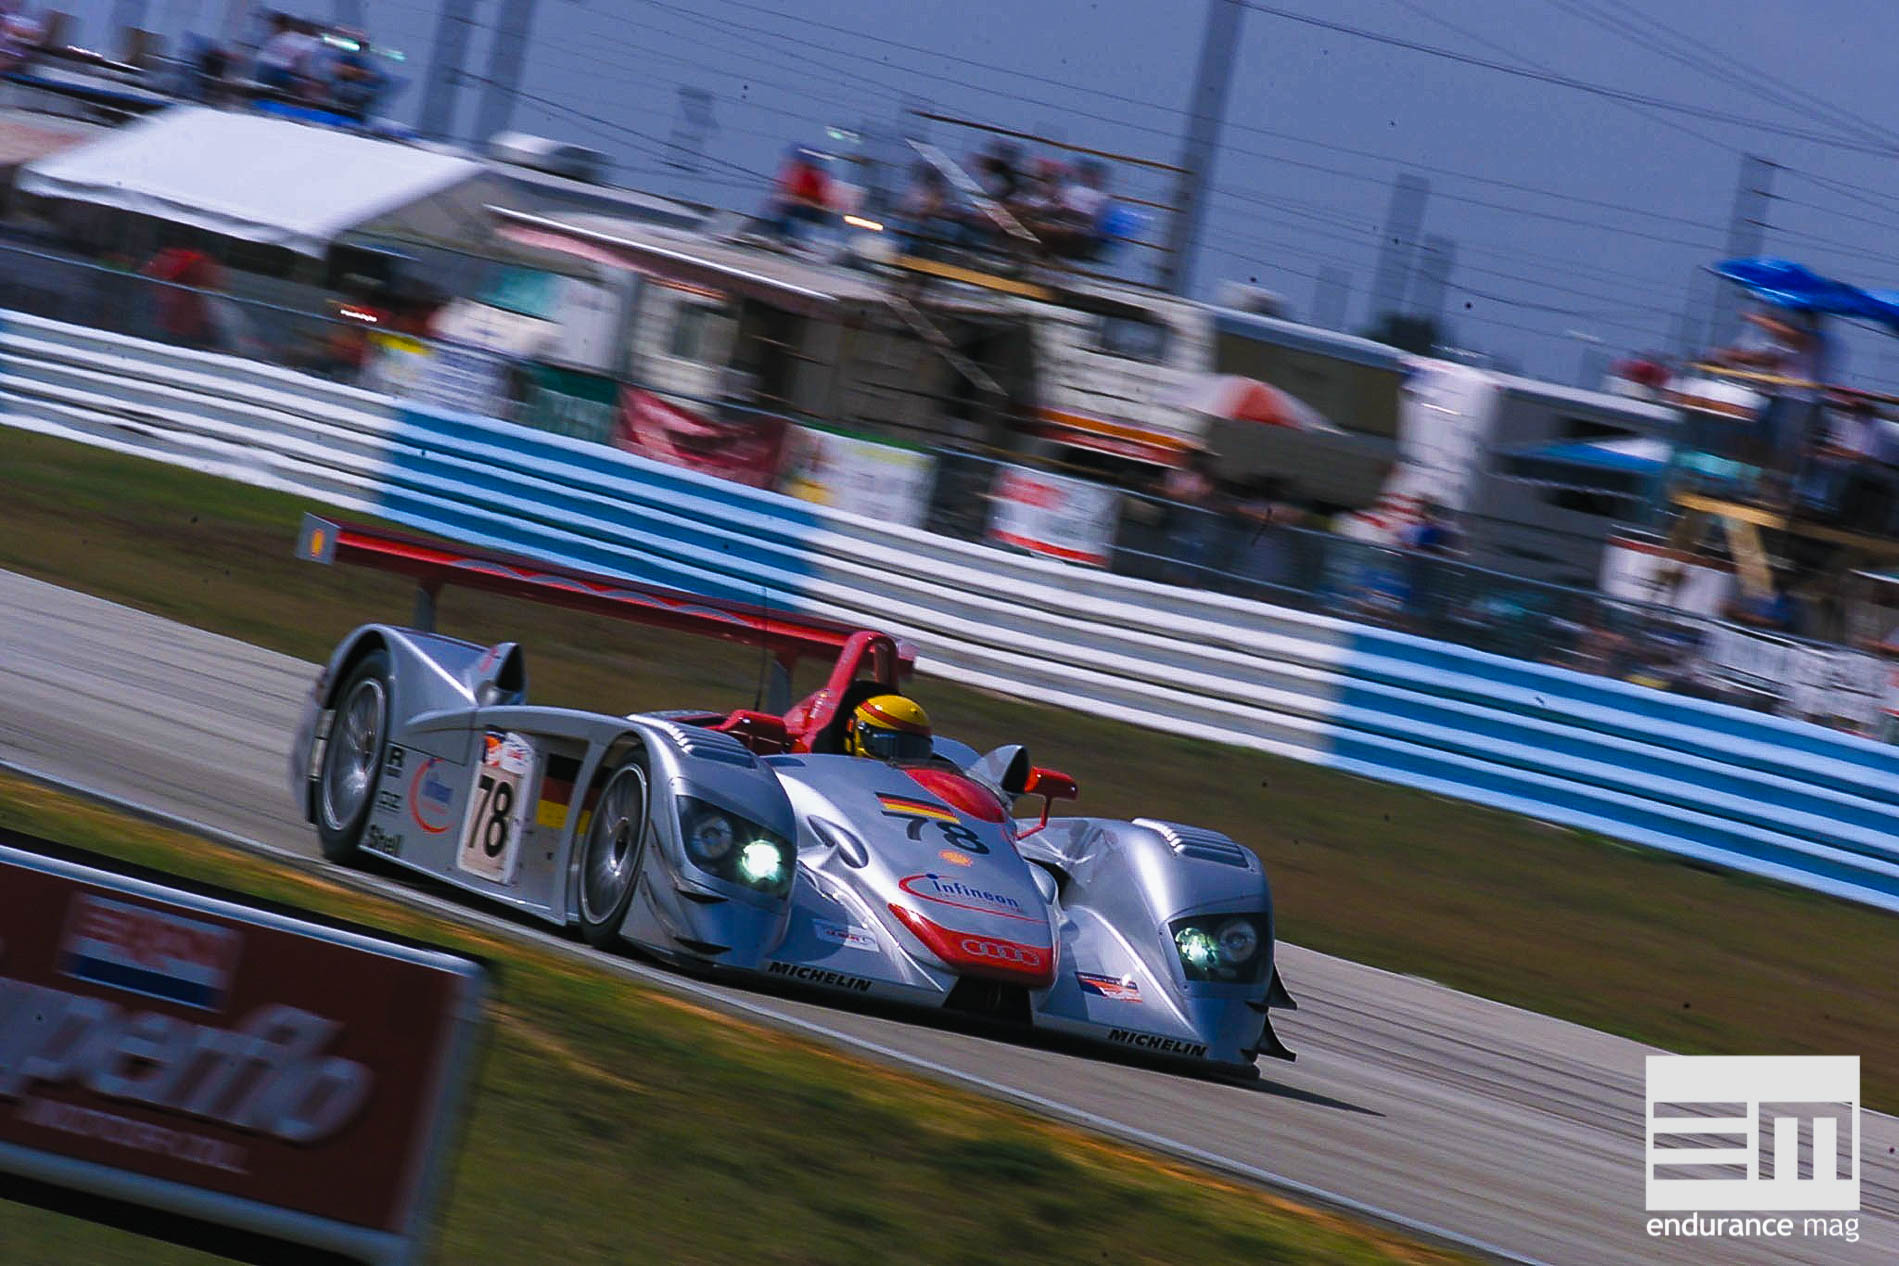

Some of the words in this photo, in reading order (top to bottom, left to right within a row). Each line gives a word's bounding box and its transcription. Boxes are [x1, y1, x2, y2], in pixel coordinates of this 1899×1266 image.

[469, 774, 513, 858] 78
[881, 809, 991, 855] 78
[768, 961, 872, 992] MICHELIN
[1108, 1028, 1208, 1057] MICHELIN
